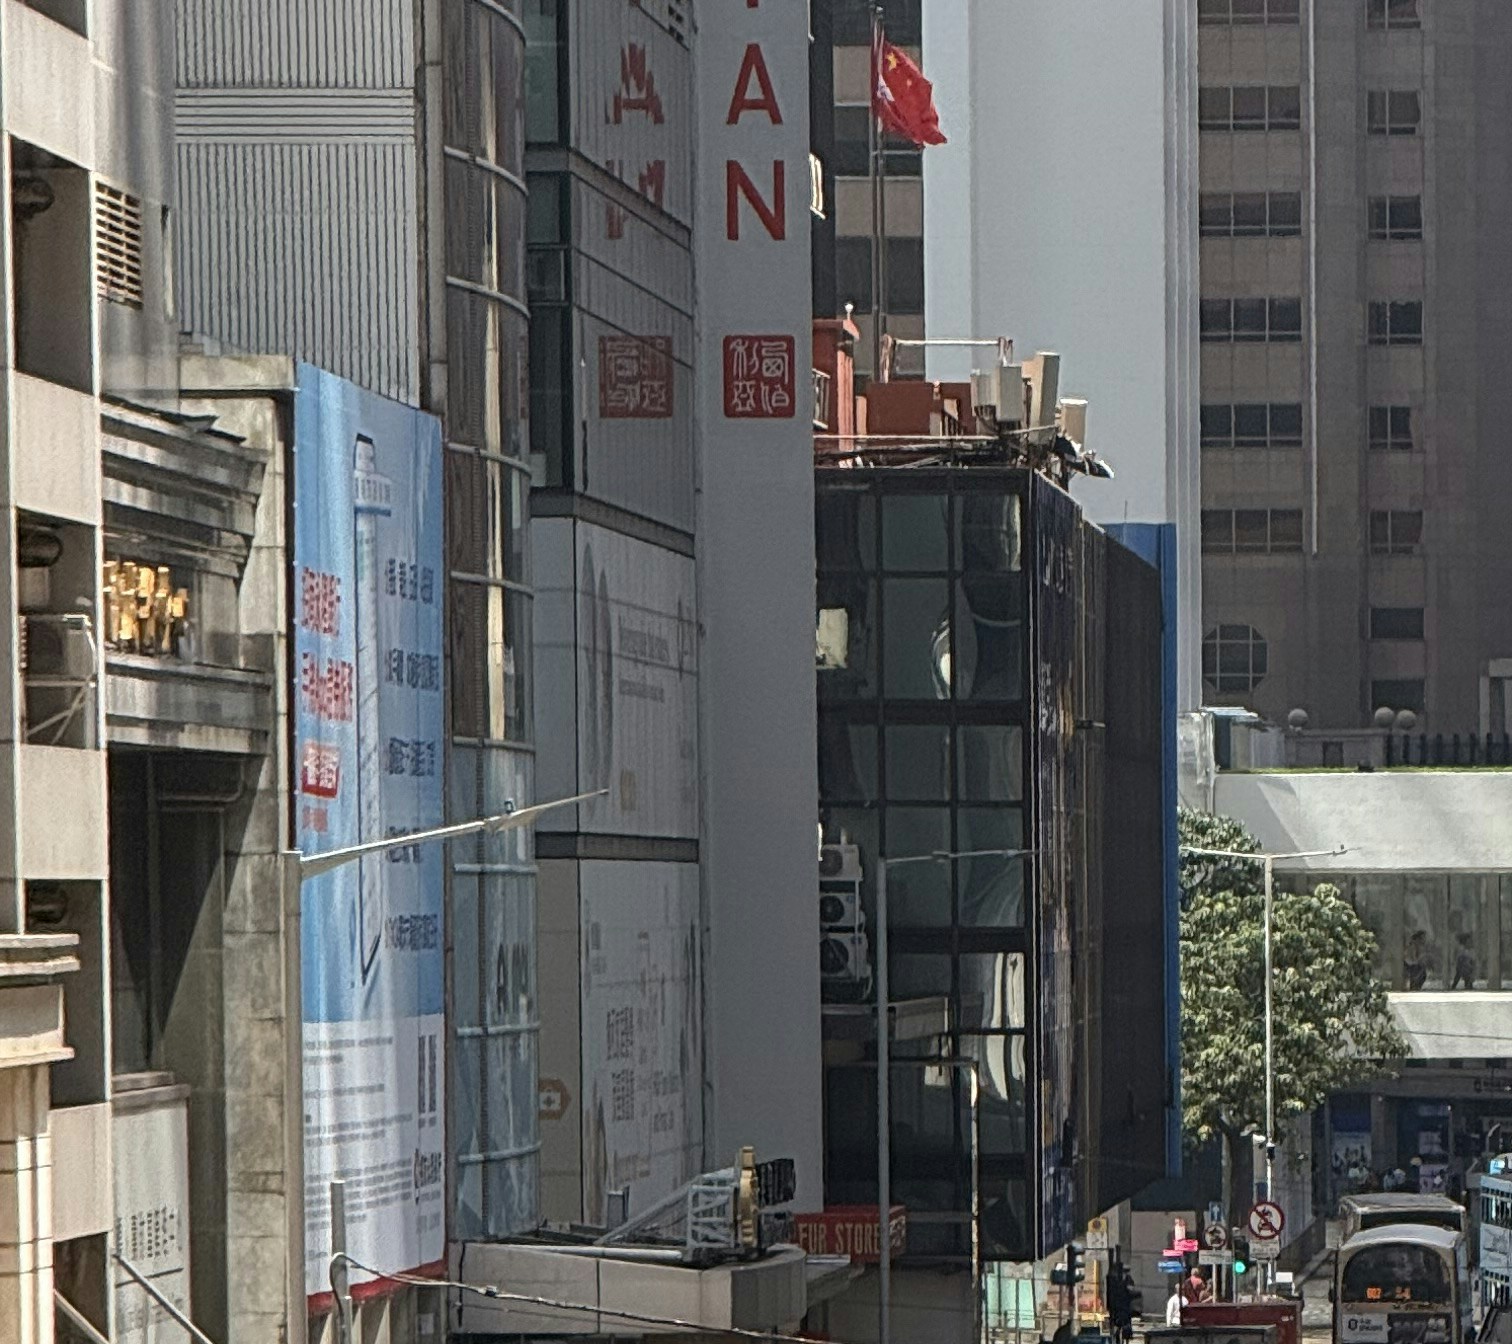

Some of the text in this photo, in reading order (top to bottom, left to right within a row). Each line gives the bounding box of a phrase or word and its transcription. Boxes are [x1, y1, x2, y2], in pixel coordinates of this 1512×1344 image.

[726, 0, 786, 241] AN
[799, 1223, 880, 1255] FUR STORE
